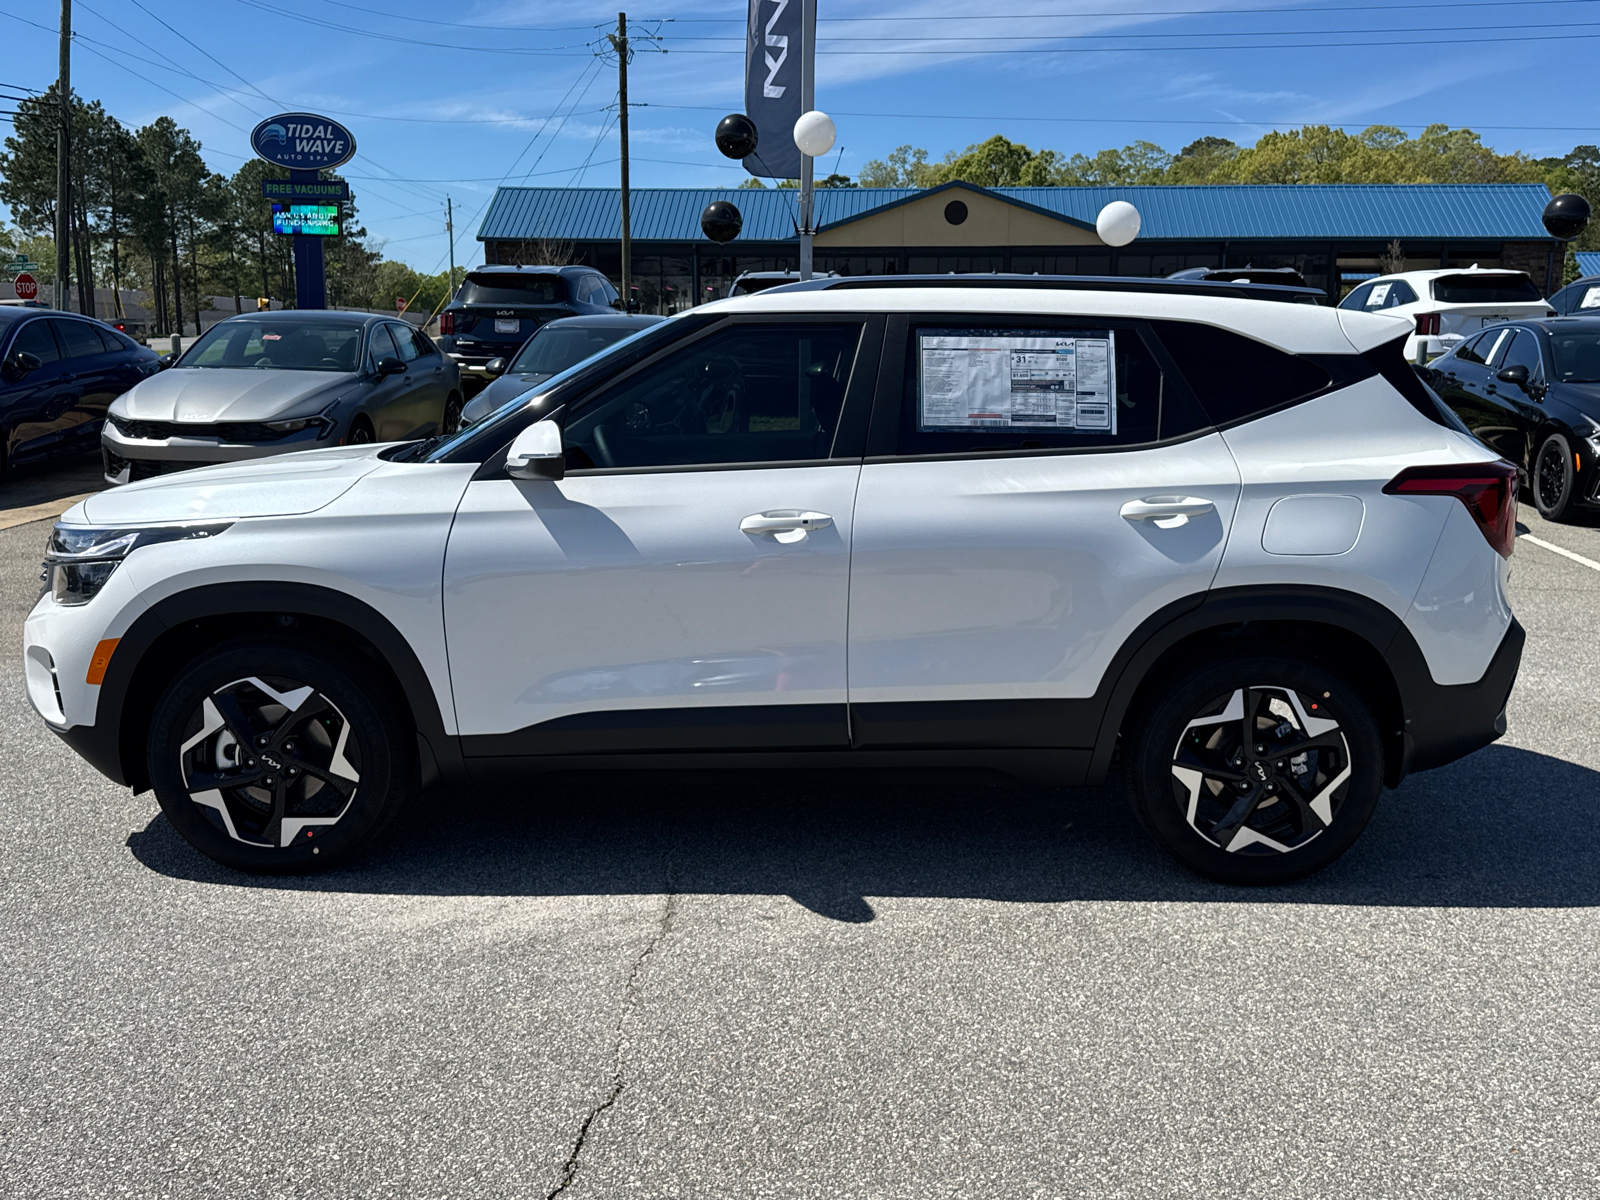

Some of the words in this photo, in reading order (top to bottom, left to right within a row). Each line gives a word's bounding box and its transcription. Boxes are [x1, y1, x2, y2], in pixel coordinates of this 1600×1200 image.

[287, 124, 334, 139] TIDAL
[295, 139, 344, 154] WAVE
[266, 184, 292, 194] FREE
[294, 184, 342, 195] VACUUMS
[16, 282, 36, 293] STOP
[1015, 355, 1027, 364] 31
[261, 754, 281, 769] KIA
[1254, 761, 1267, 781] KIA
